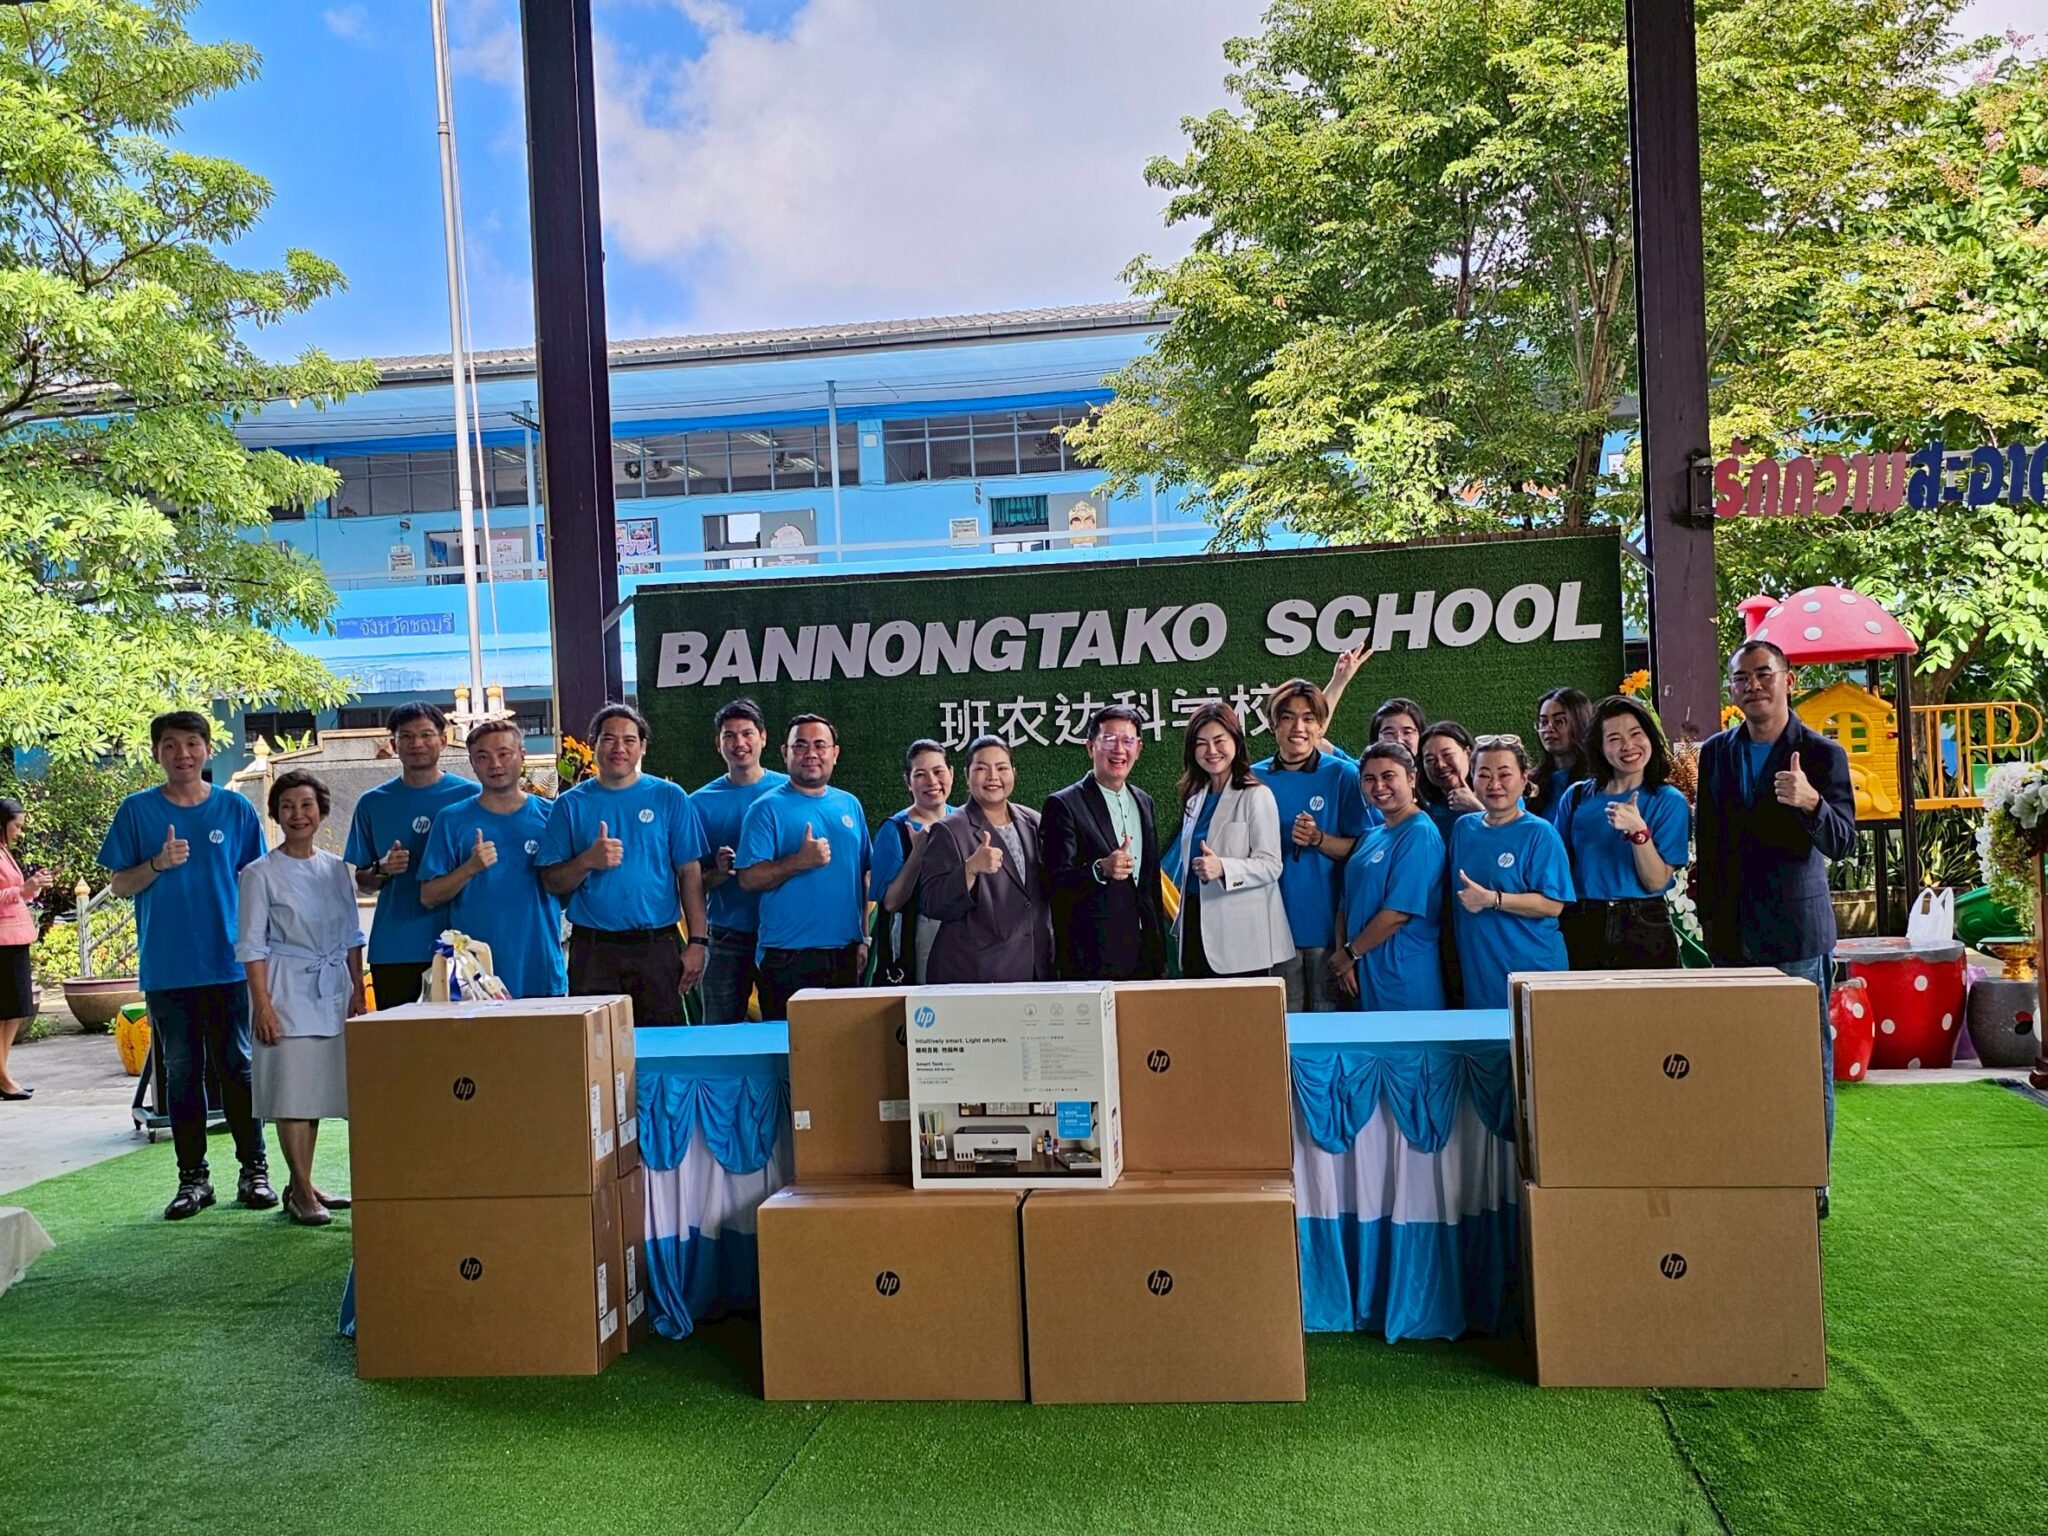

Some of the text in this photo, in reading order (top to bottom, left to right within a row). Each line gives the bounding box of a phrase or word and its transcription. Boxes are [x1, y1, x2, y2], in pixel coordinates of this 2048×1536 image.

[360, 613, 453, 636] จังหวัดชลบุรี
[656, 581, 1602, 689] BANNONGTAKO SCHOOL
[1311, 796, 1323, 811] hp
[414, 816, 430, 833] hp
[640, 809, 653, 823] hp
[210, 829, 223, 844] hp
[525, 840, 538, 854] hp
[1499, 852, 1513, 868] hp
[917, 1007, 934, 1028] hp
[1149, 1049, 1169, 1073] hp
[1665, 1054, 1687, 1080] hp
[455, 1077, 474, 1101] hp
[462, 1257, 481, 1281] hp
[1663, 1253, 1685, 1279] hp
[879, 1271, 898, 1296] hp
[1150, 1270, 1171, 1296] hp
